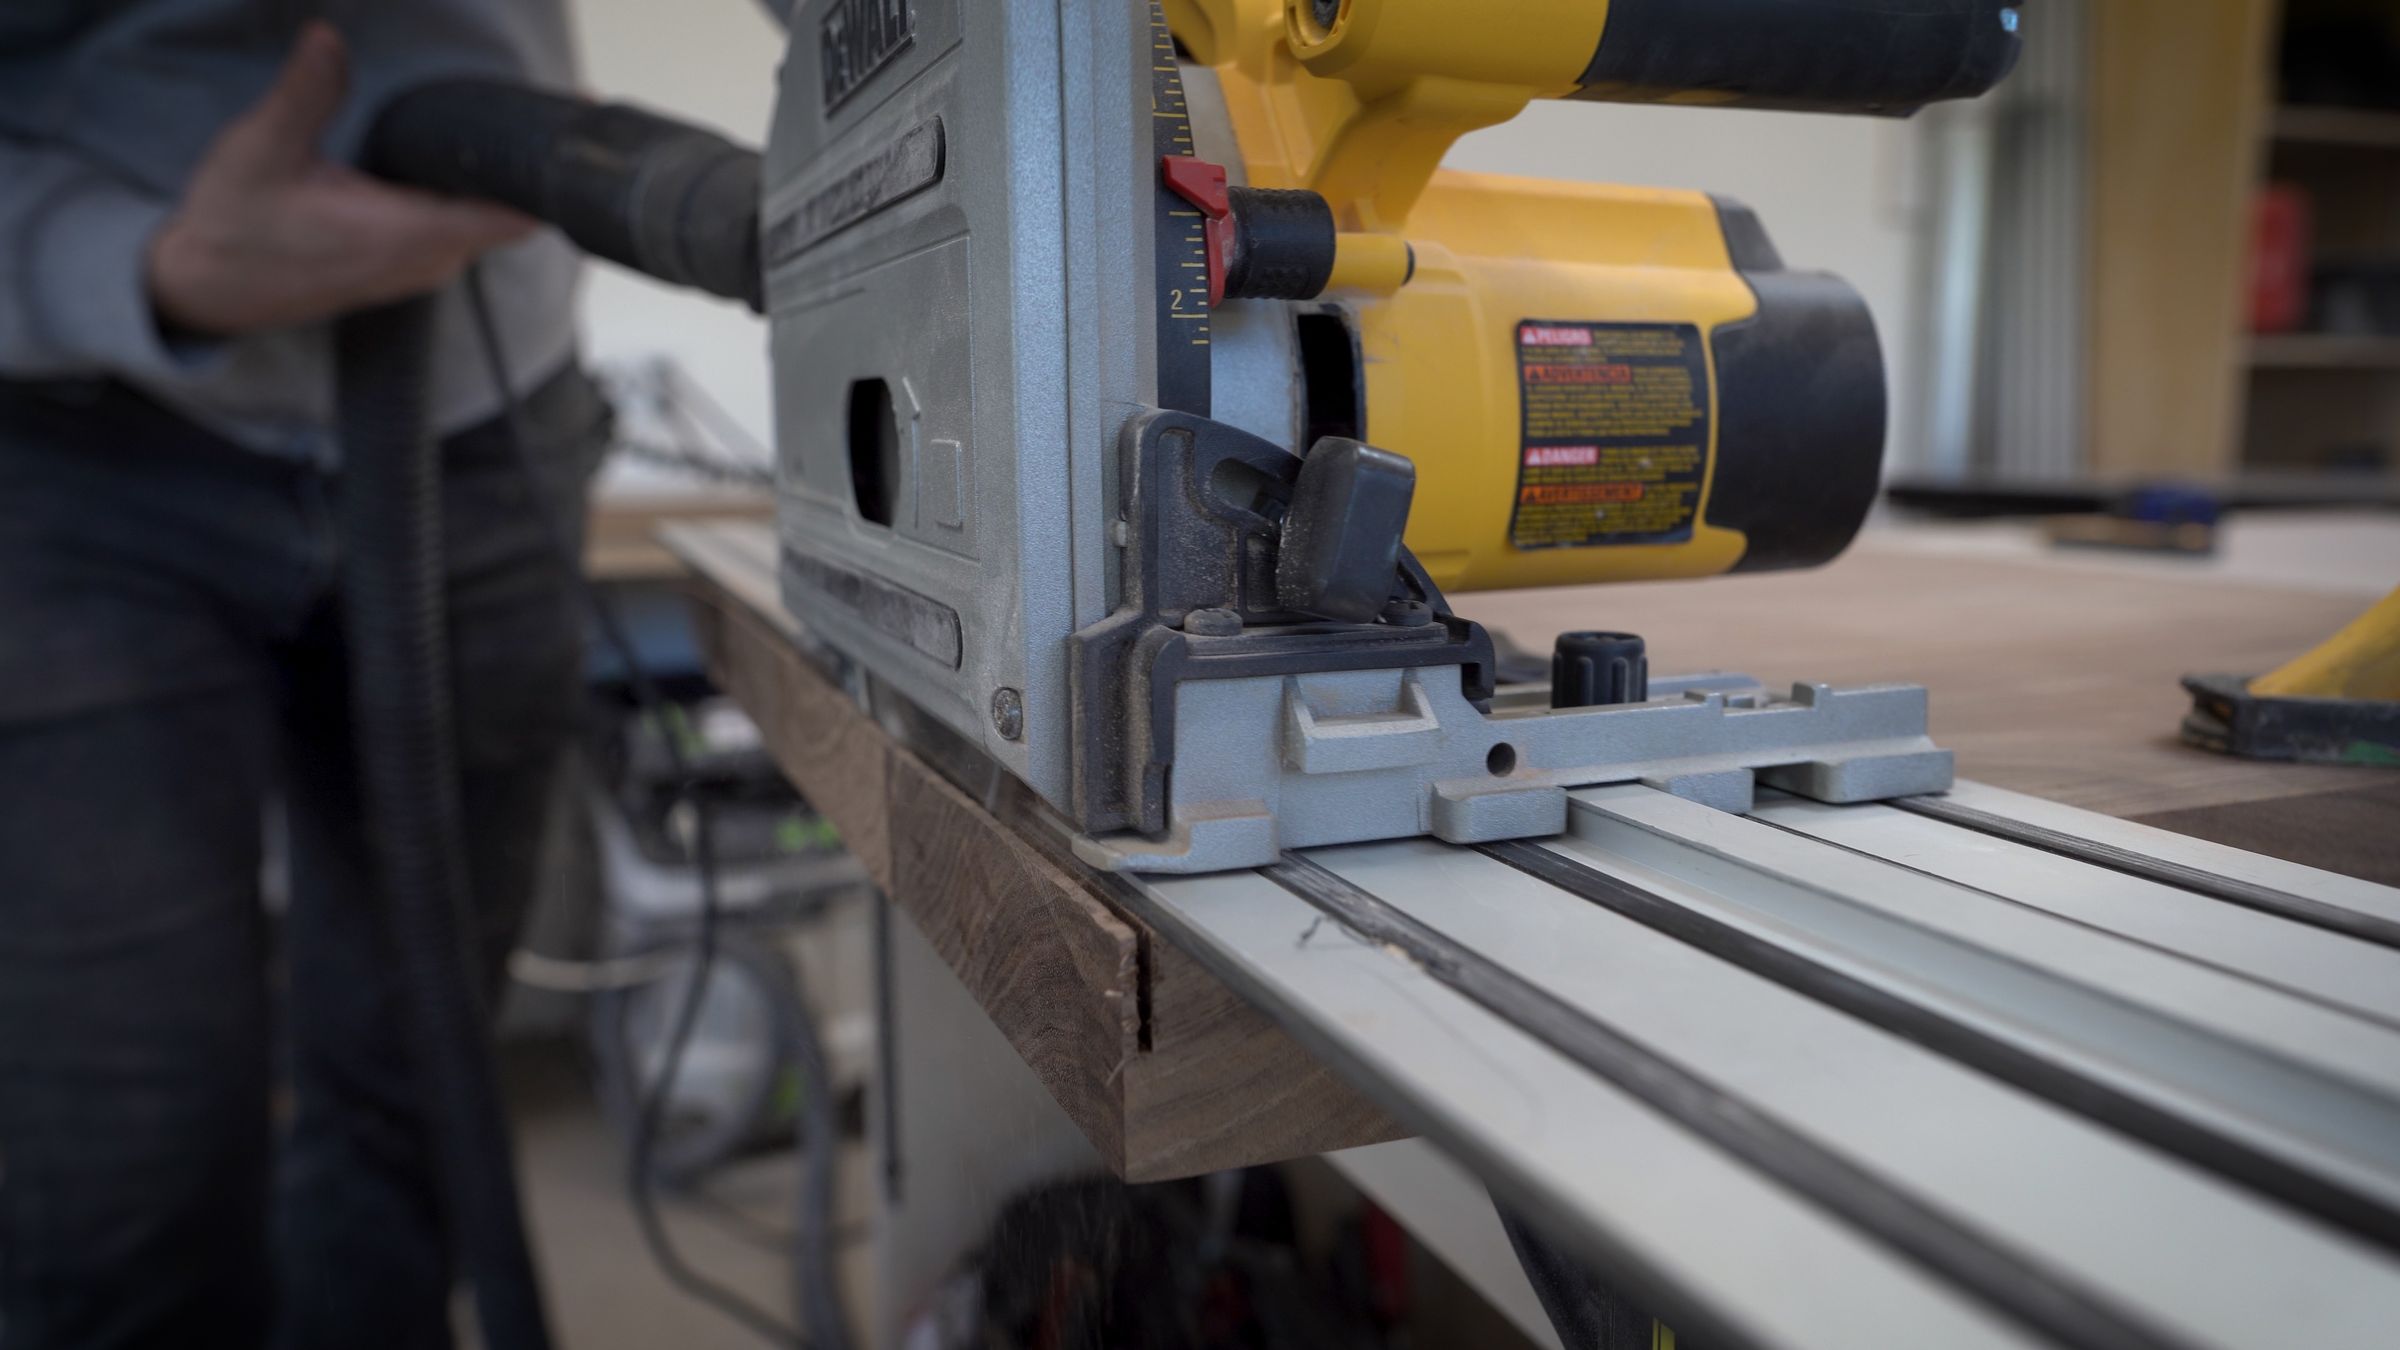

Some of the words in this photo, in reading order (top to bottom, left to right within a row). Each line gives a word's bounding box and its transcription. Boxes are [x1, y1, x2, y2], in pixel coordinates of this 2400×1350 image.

[1170, 289, 1183, 310] 2
[1536, 328, 1590, 345] PELIGRO
[1543, 366, 1628, 382] ADVERTENCIA
[1540, 447, 1597, 465] DANGER
[1537, 485, 1638, 502] AVERTISSEMENT
